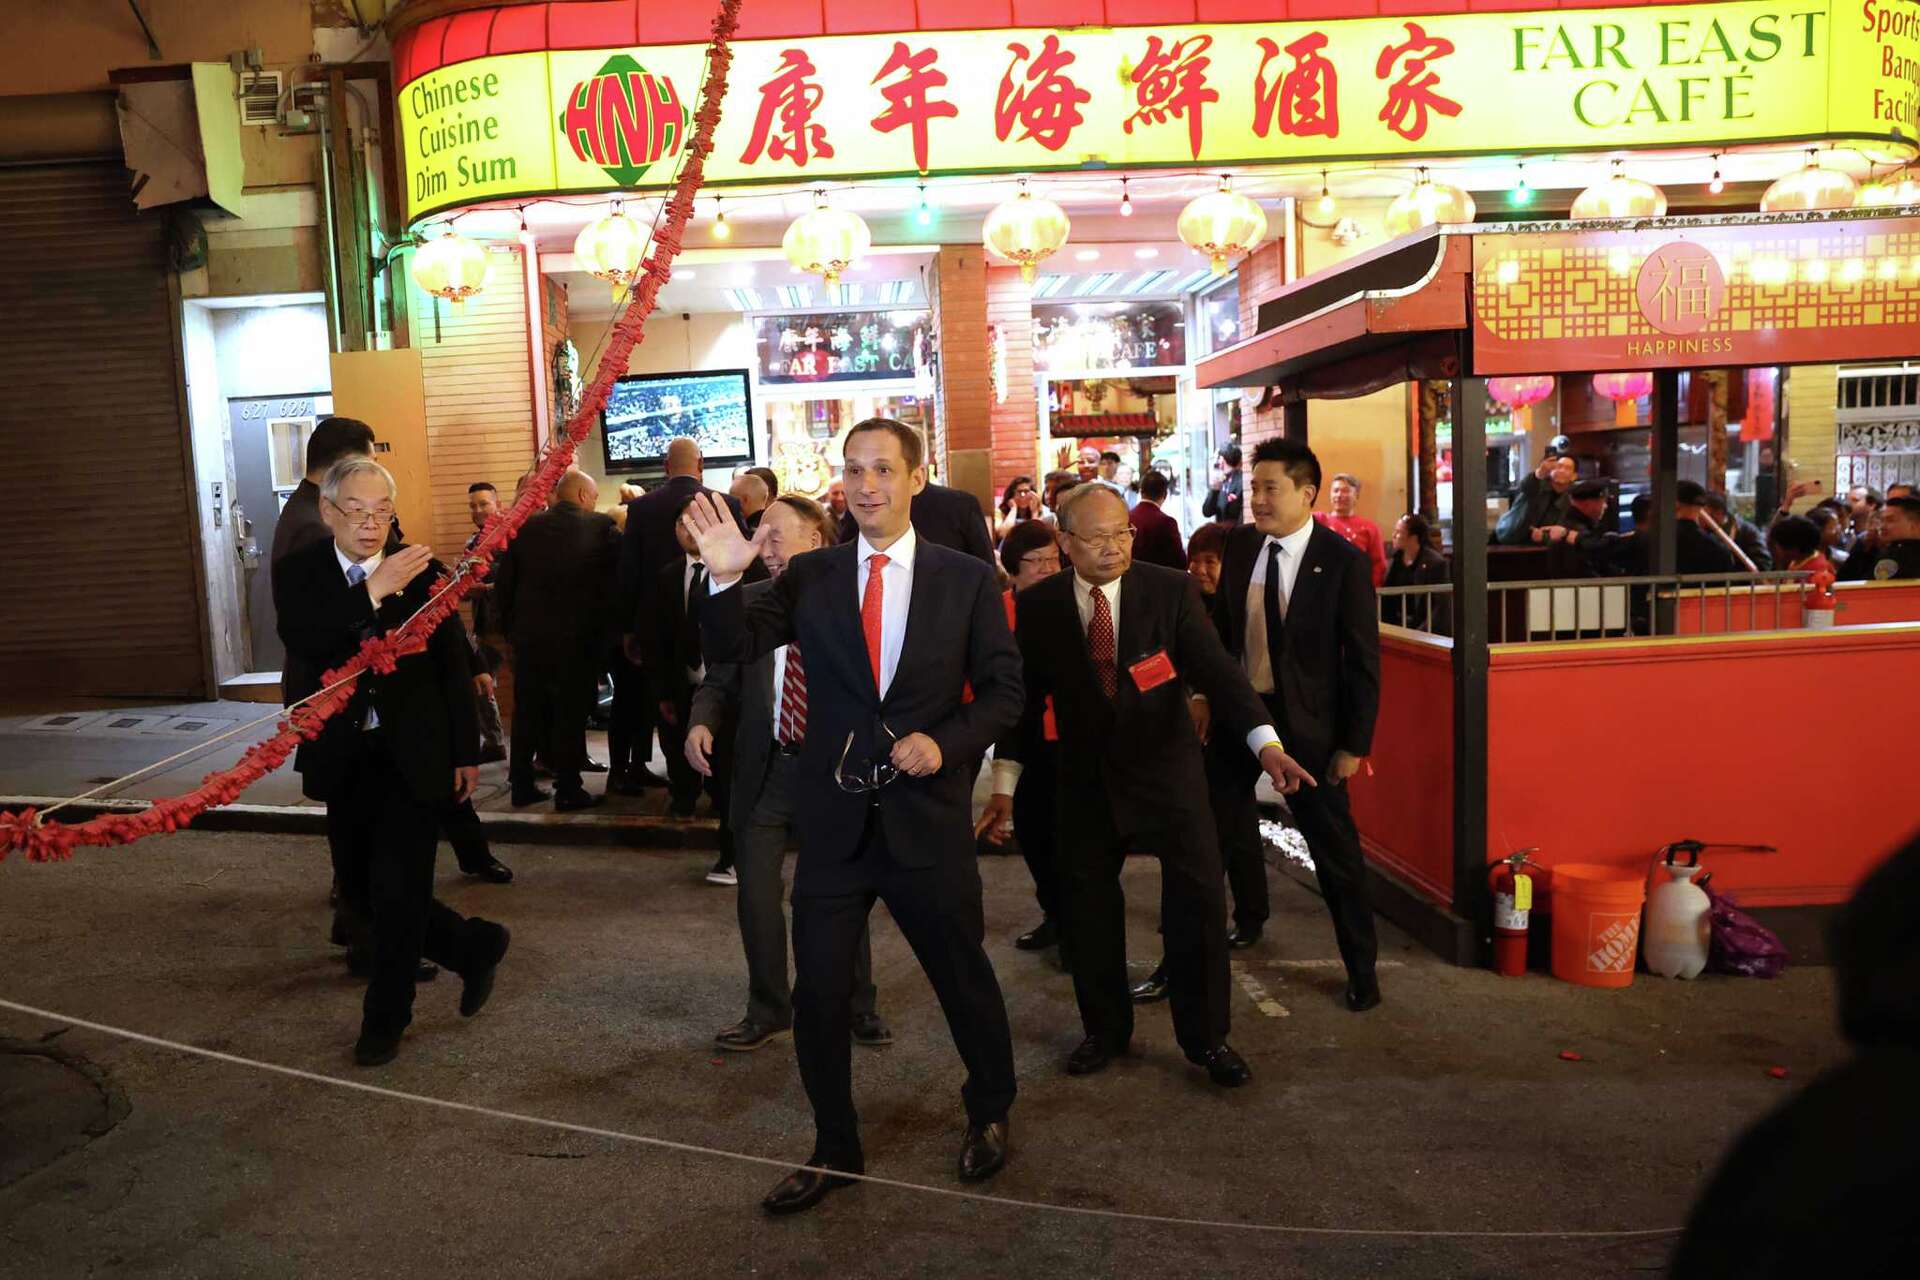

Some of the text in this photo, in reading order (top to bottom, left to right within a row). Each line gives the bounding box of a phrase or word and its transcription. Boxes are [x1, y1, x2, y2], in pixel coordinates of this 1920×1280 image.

[1511, 10, 1826, 71] FAR EAST
[412, 72, 499, 119] Chinese
[565, 72, 684, 167] HNH
[738, 21, 1464, 174] 康年海鮮酒家
[1573, 65, 1755, 129] CAFÉ
[419, 111, 498, 158] Cuisine
[416, 155, 516, 202] Dim Sum
[1648, 254, 1713, 323] 福
[1627, 337, 1734, 357] HAPPINESS
